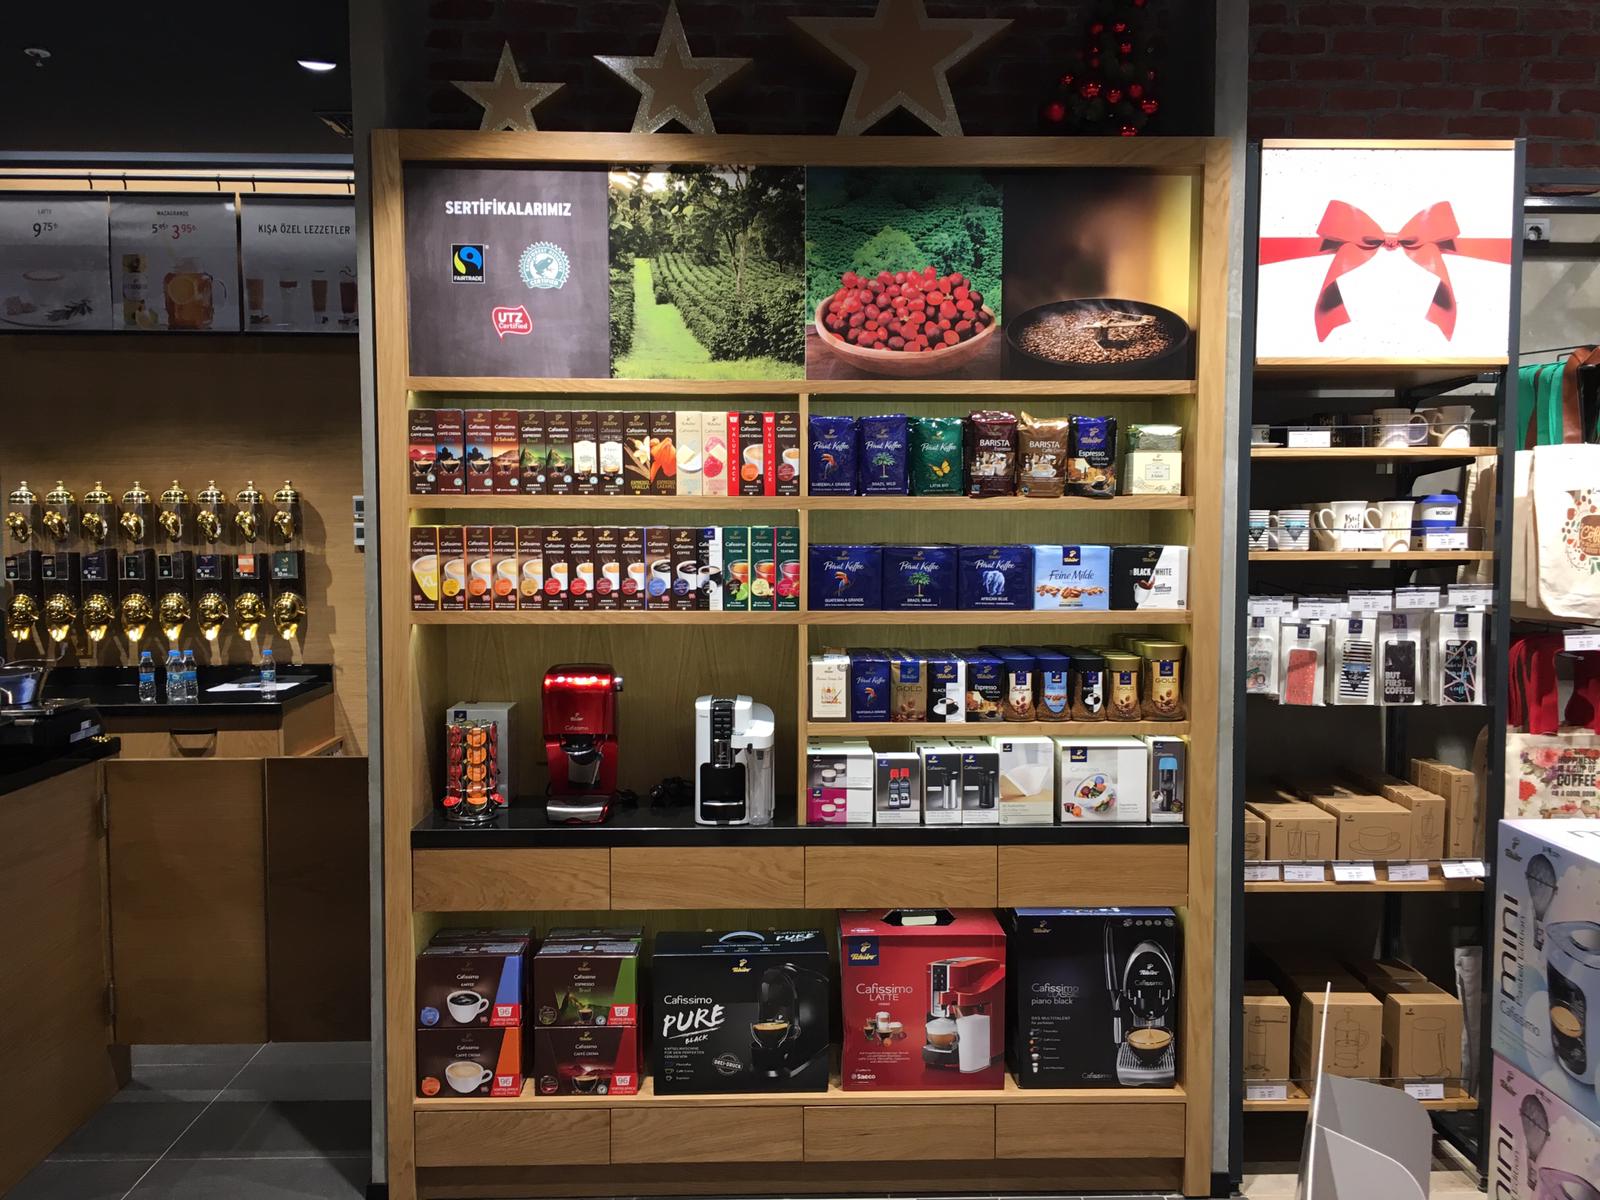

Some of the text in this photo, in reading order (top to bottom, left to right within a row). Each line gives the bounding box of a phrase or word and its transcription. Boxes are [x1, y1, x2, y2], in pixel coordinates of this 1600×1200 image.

[445, 198, 571, 216] SERTİFİKALARIMIZ
[258, 222, 350, 236] KIŞA ÖZEL LEZZETLER
[498, 312, 523, 322] UTZ
[980, 439, 1010, 447] BARISTA
[1078, 450, 1105, 458] Espresso
[1049, 570, 1094, 582] Feine Milde
[1133, 568, 1172, 576] BLACK WHITE
[1588, 765, 1596, 773] OF
[1557, 774, 1596, 786] COFFEE
[856, 983, 914, 995] Cafissimo
[1031, 983, 1080, 993] Cafissimo
[664, 995, 712, 1005] Cafissimo
[1031, 997, 1073, 1005] piano black
[662, 1004, 726, 1038] PURE
[685, 1034, 709, 1045] BLACK
[500, 1077, 511, 1085] 96
